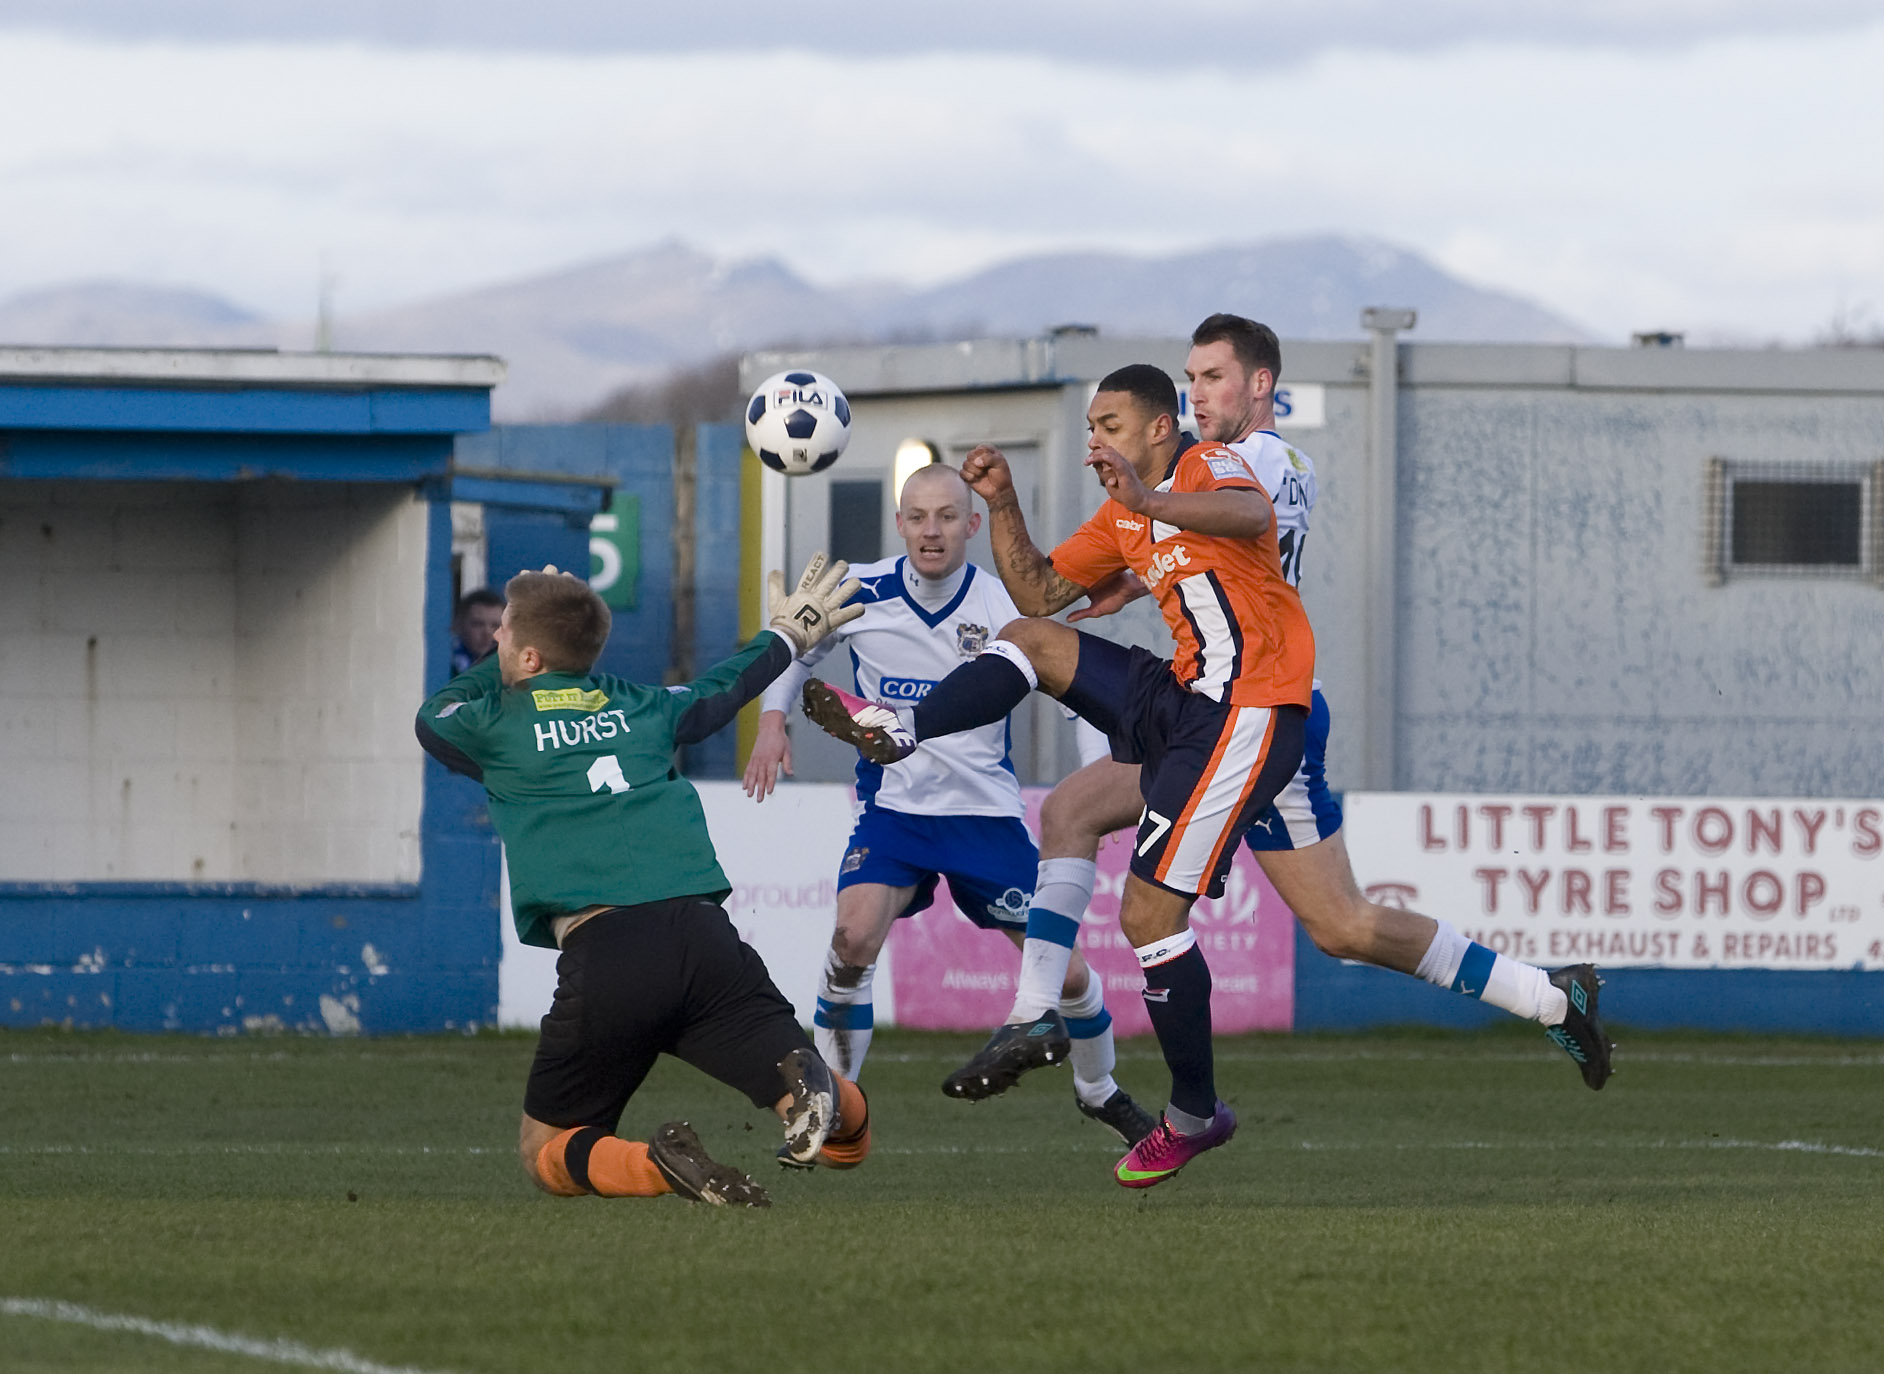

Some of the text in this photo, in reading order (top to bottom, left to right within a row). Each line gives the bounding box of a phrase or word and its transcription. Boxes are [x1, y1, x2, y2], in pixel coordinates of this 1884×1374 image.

[778, 388, 823, 405] FILA
[883, 681, 932, 698] COR
[533, 709, 631, 751] HURST
[1138, 810, 1171, 857] 7
[1418, 804, 1884, 860] LITTLE TONY'S
[1474, 866, 1632, 917] TYRE
[1653, 868, 1827, 918] SHOP
[1549, 930, 1682, 960] EXHAUST
[1691, 932, 1714, 960] &
[1723, 932, 1837, 960] REPAIRS
